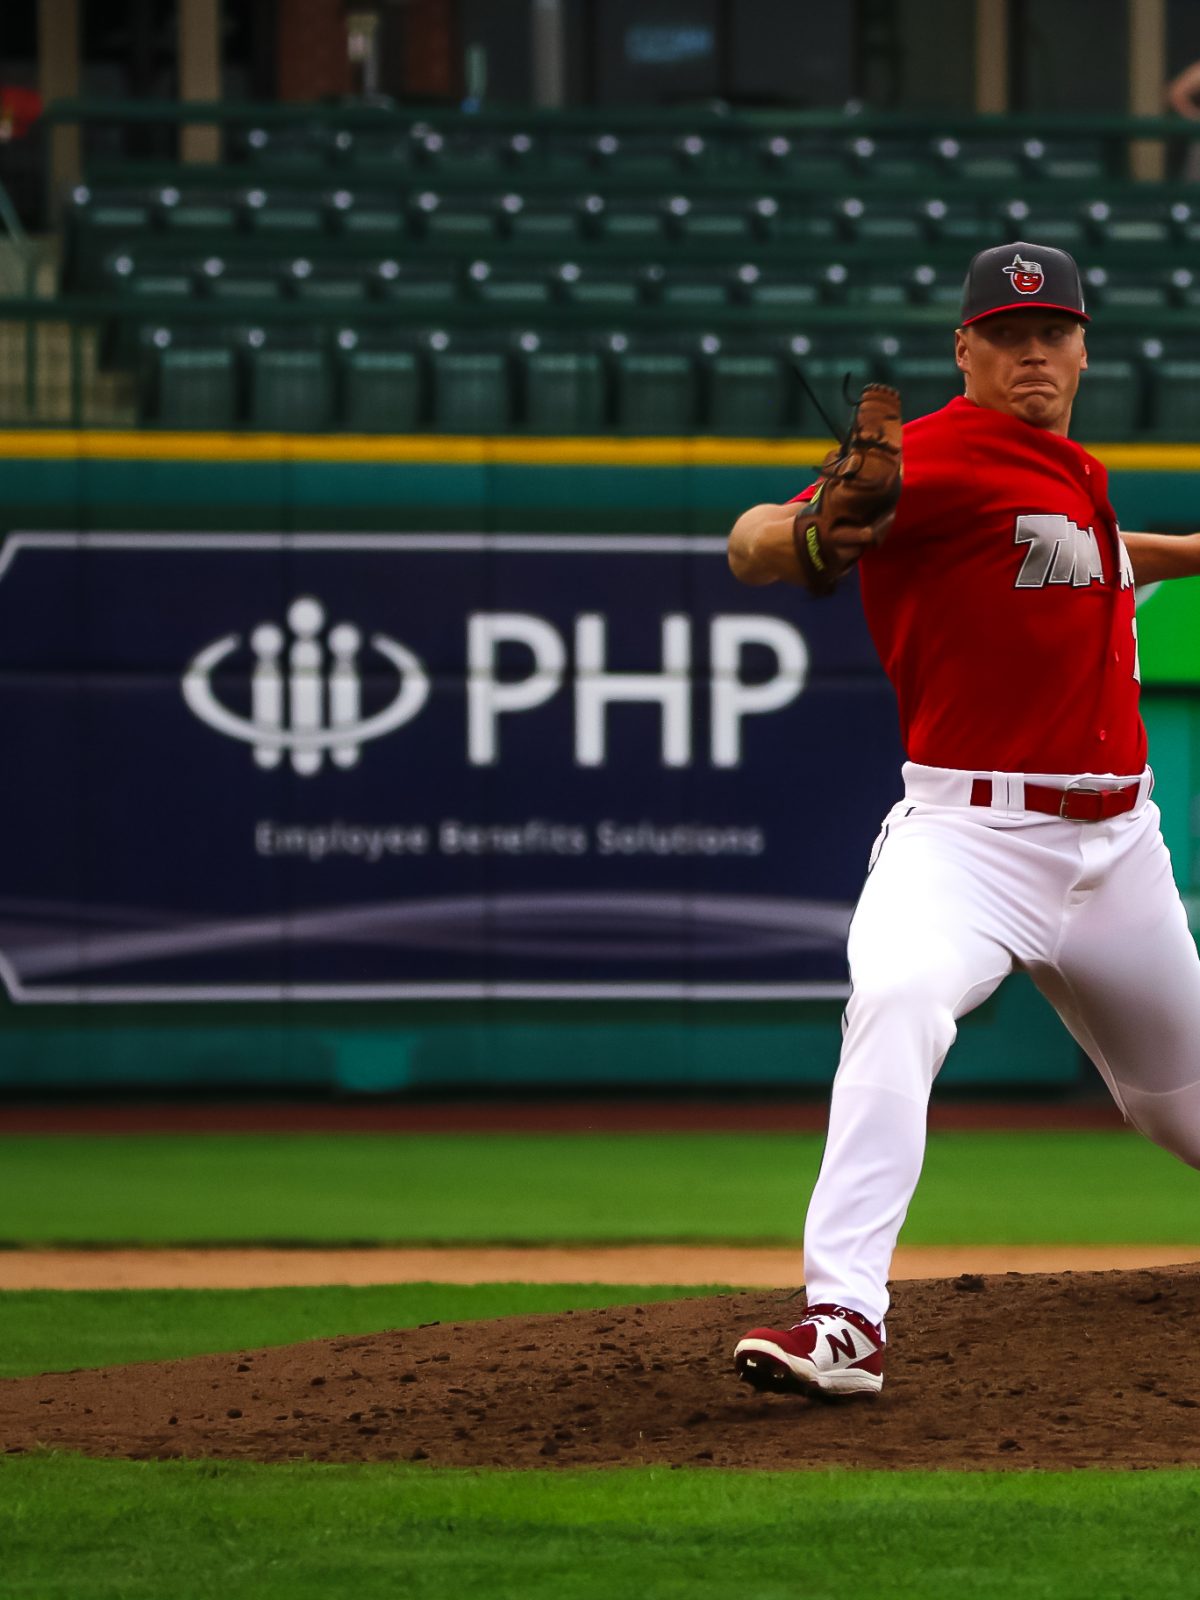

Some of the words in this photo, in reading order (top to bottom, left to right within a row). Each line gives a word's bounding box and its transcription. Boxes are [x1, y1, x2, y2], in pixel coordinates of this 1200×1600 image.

[467, 612, 809, 768] PHP
[255, 819, 428, 861] Employee
[439, 819, 587, 855] Benefits
[598, 819, 765, 855] Solutions
[825, 1328, 857, 1364] N
